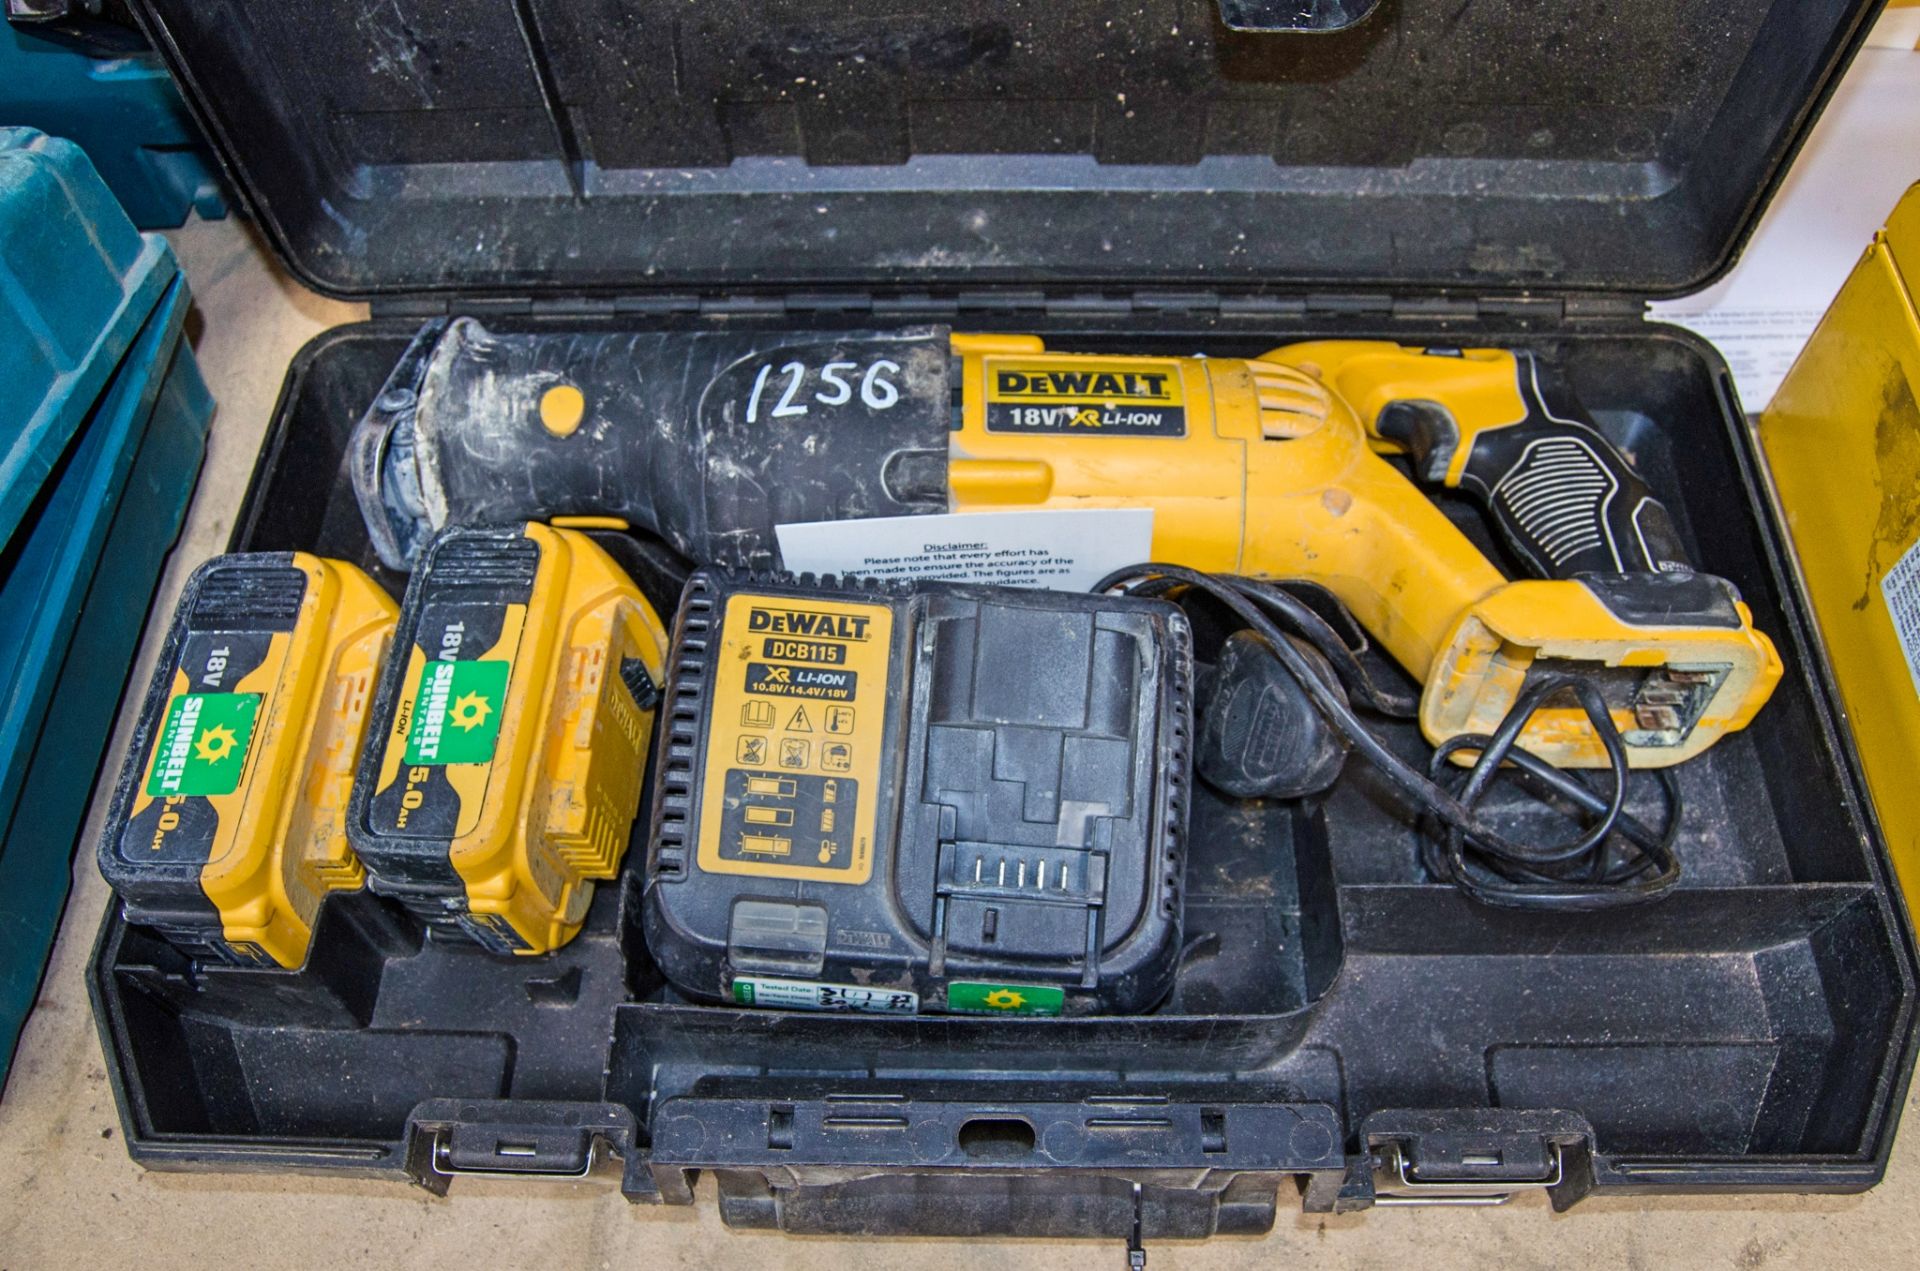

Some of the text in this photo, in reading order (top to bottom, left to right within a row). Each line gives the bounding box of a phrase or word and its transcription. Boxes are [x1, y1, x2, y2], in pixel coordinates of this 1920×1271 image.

[747, 360, 900, 423] 1256
[1010, 408, 1162, 427] 18V XR LI-ION
[864, 556, 901, 565] Please
[904, 554, 931, 563] note
[933, 551, 957, 560] that
[960, 551, 991, 559] every
[994, 549, 1026, 557] effort
[923, 541, 988, 552] Disclaimer:
[841, 569, 870, 577] been
[873, 566, 906, 575] made
[923, 562, 962, 570] ensure
[965, 560, 985, 569] the
[987, 559, 1037, 567] accuracy
[1040, 557, 1052, 566] of
[1055, 556, 1075, 565] the
[973, 570, 994, 578] The
[996, 568, 1035, 577] figures
[748, 607, 871, 641] DEWALT
[438, 621, 465, 662] 18V
[772, 641, 838, 662] DCB115
[202, 646, 230, 688] 18V
[764, 665, 847, 686] XR LI-ION
[396, 699, 412, 736] LI-ION
[413, 676, 434, 746] RENTALS
[419, 663, 456, 760] SUNBELT
[155, 709, 182, 778] RENTALS
[160, 696, 204, 792] SUNBELT
[760, 983, 789, 992] Tested
